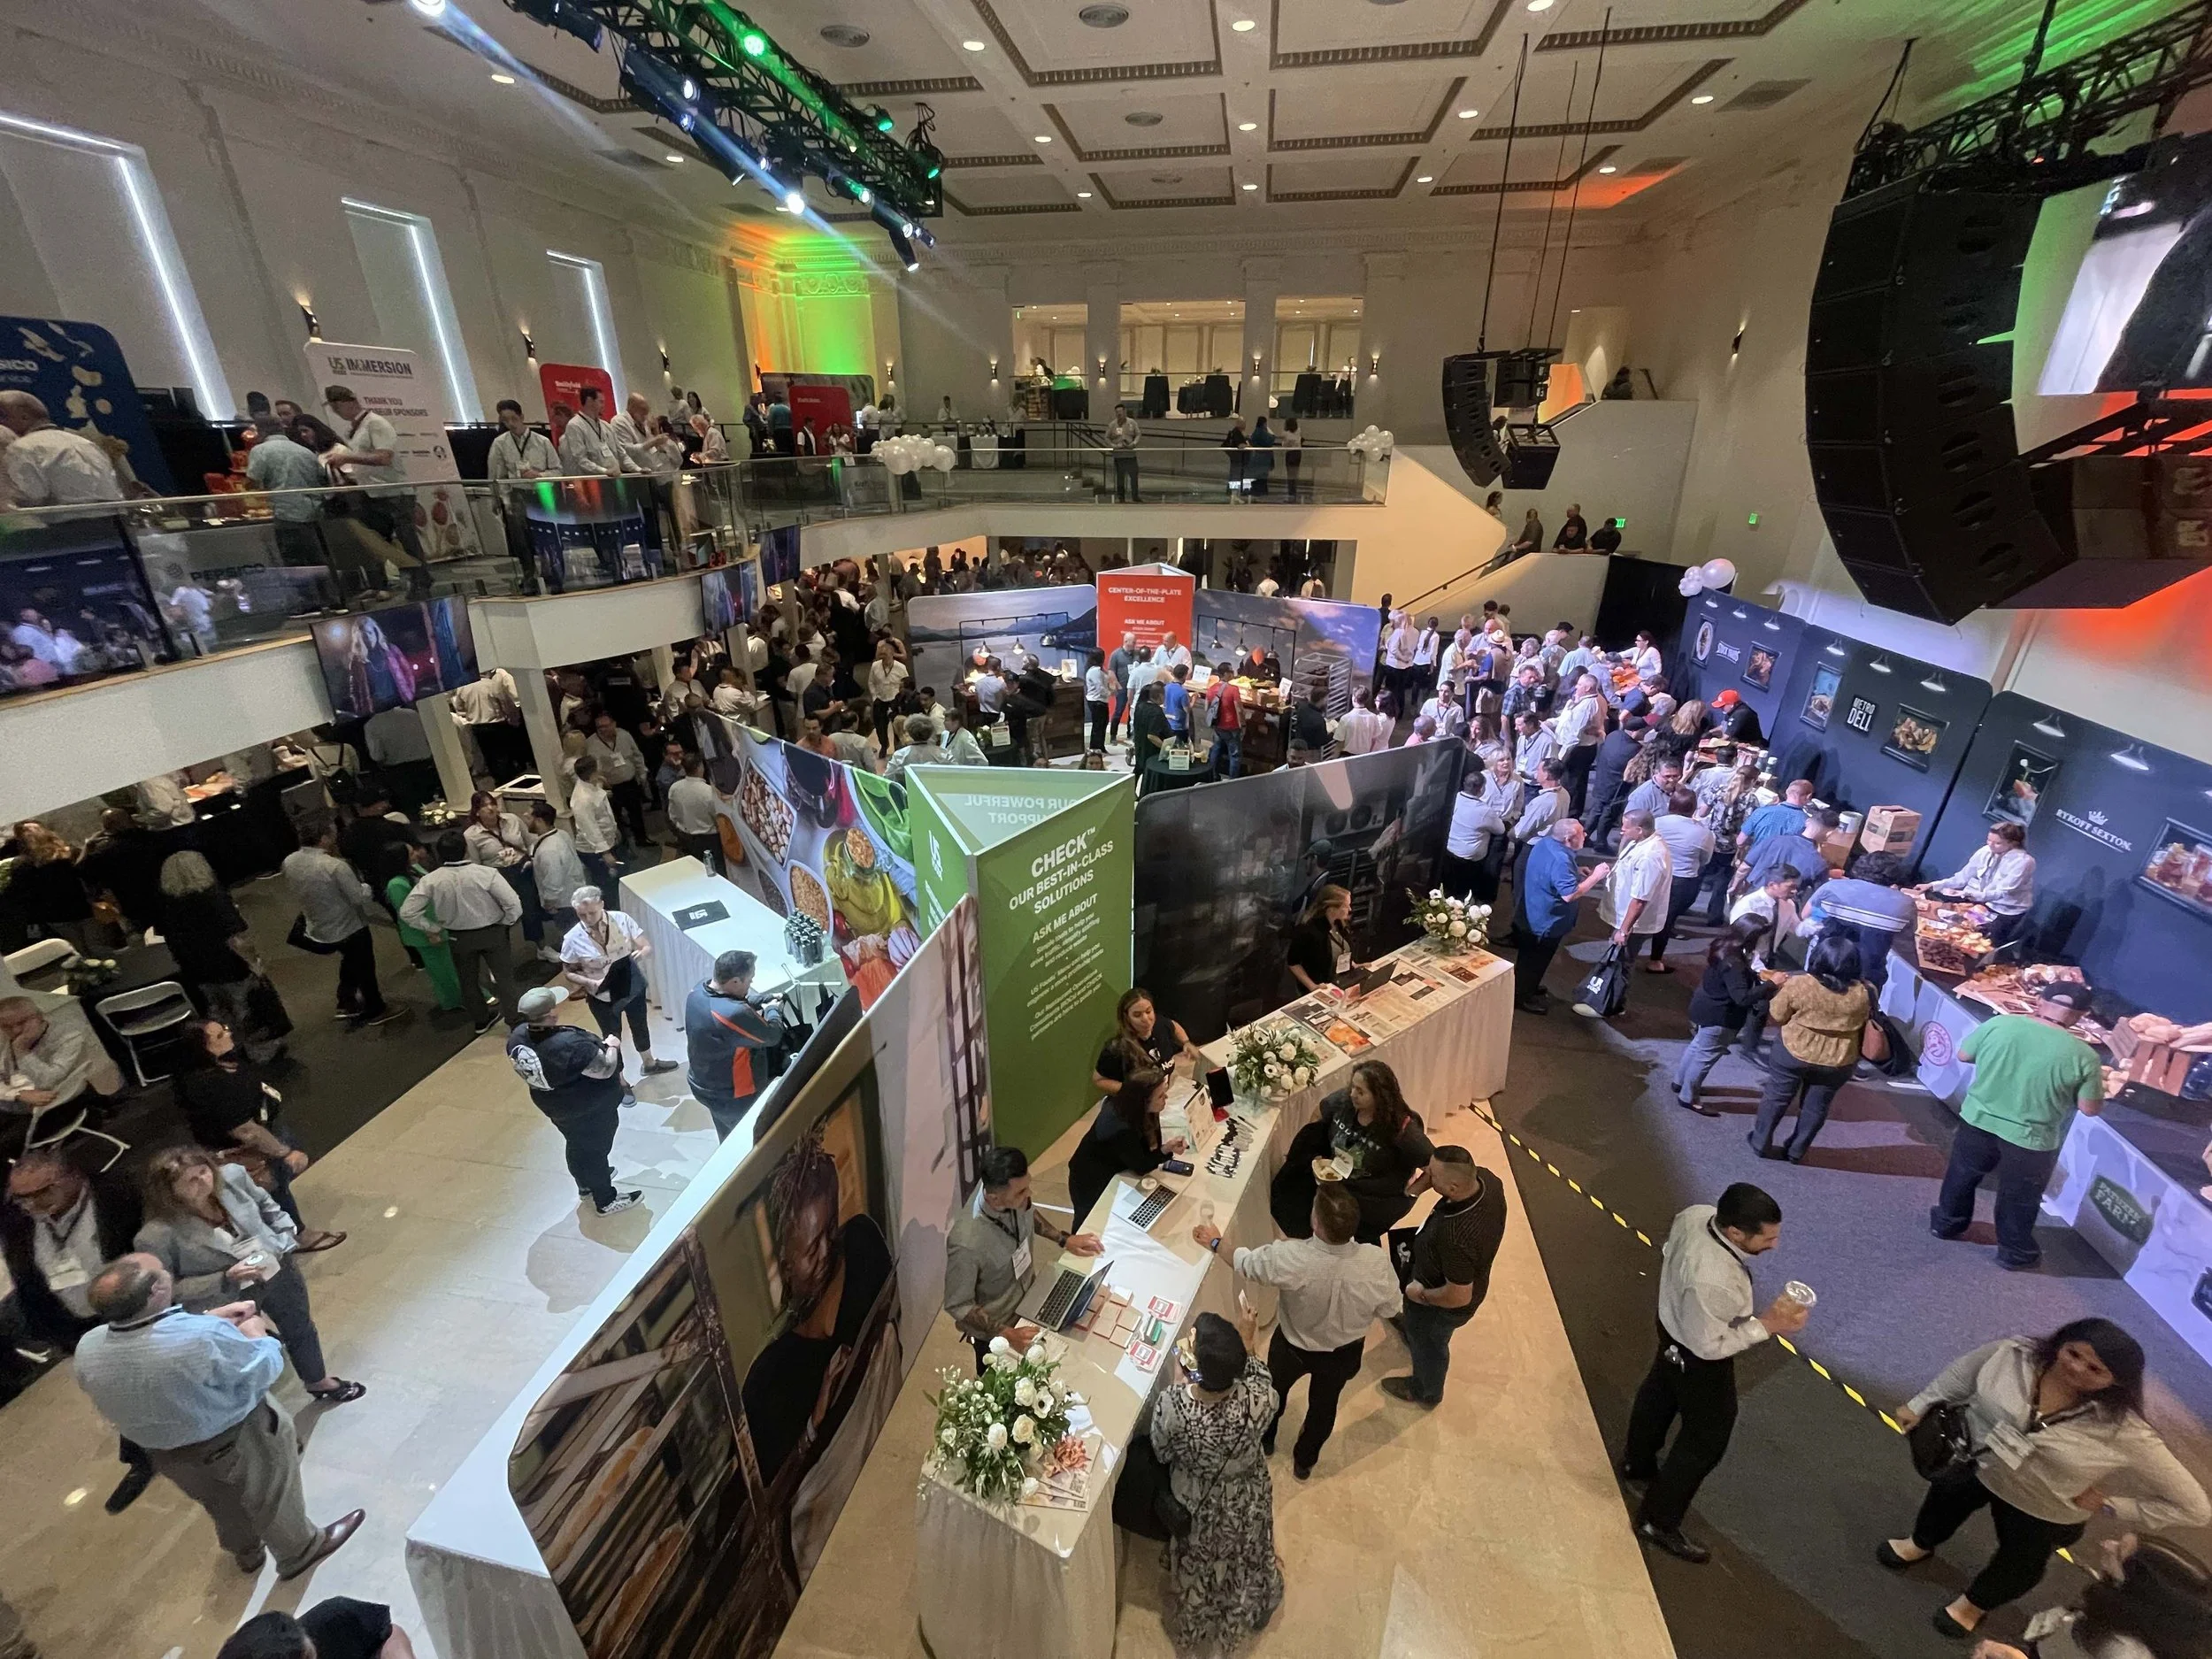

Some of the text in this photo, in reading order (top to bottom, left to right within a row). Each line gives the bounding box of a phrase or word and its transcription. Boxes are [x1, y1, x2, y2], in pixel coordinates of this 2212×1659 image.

[345, 357, 412, 375] IMMERSION
[1108, 587, 1182, 595] CENTER-OF-THE-PLATE
[1853, 697, 1876, 715] METRO
[1847, 707, 1872, 733] DELI
[2055, 809, 2132, 851] RYKOFF SEXTON
[1009, 840, 1114, 910] OUR BEST-IN-CLASS
[1033, 869, 1094, 915] SOLUTIONS
[1033, 893, 1098, 944] ASK ME ABOUT
[1086, 912, 1094, 924] you
[1031, 984, 1039, 995] US
